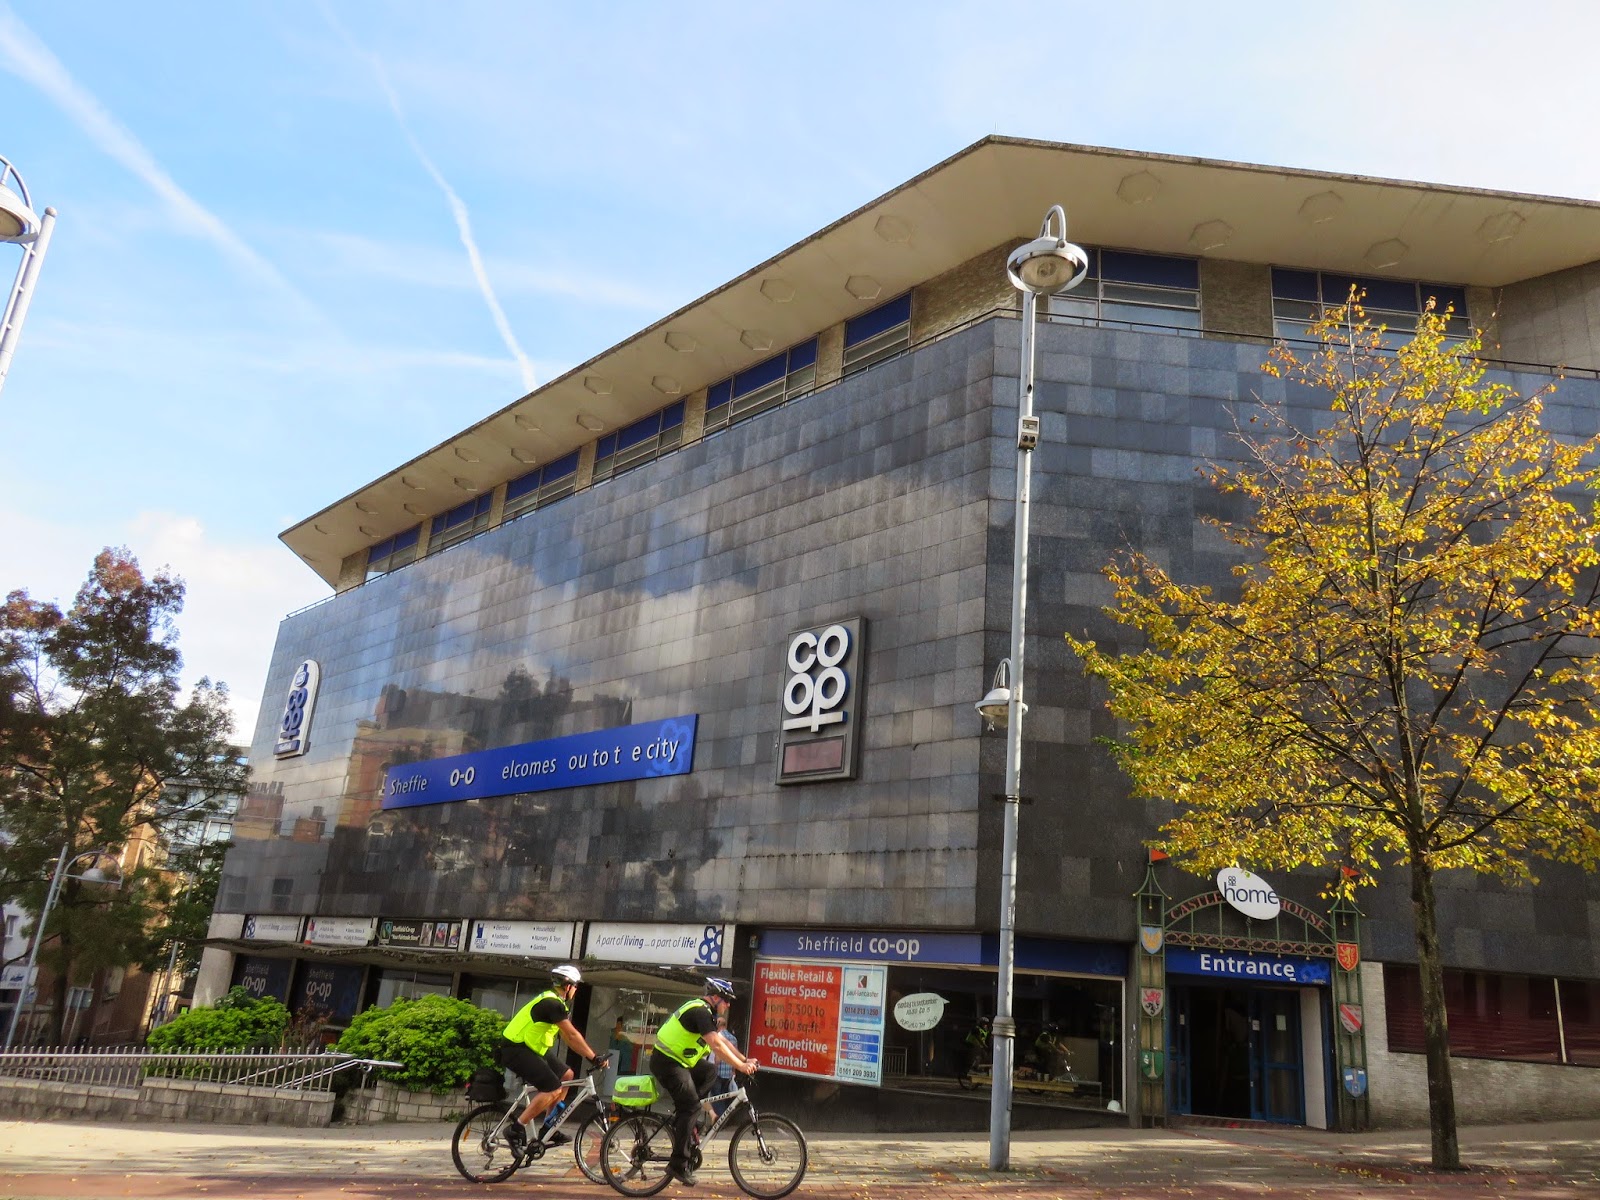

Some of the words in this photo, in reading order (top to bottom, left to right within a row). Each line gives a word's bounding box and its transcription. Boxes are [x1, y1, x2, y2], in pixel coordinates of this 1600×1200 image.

[501, 757, 556, 780] elcomes
[592, 749, 608, 767] to
[646, 737, 679, 763] city
[1223, 881, 1279, 905] home
[596, 934, 601, 945] A
[601, 936, 616, 946] part
[616, 935, 624, 945] of
[623, 935, 644, 949] living
[656, 938, 672, 948] part
[673, 937, 681, 948] of
[681, 936, 698, 949] life!
[797, 936, 863, 953] Sheffield
[868, 937, 920, 961] co-op
[1199, 953, 1295, 977] Entrance
[760, 967, 796, 981] Flexible
[797, 970, 825, 983] Retail
[826, 971, 834, 984] &
[305, 980, 333, 1002] co-op
[764, 982, 797, 997] Leisure
[798, 985, 828, 1000] Space
[815, 1005, 826, 1018] to
[755, 1034, 766, 1046] at
[767, 1034, 828, 1054] Competitive
[771, 1051, 808, 1069] Rentals
